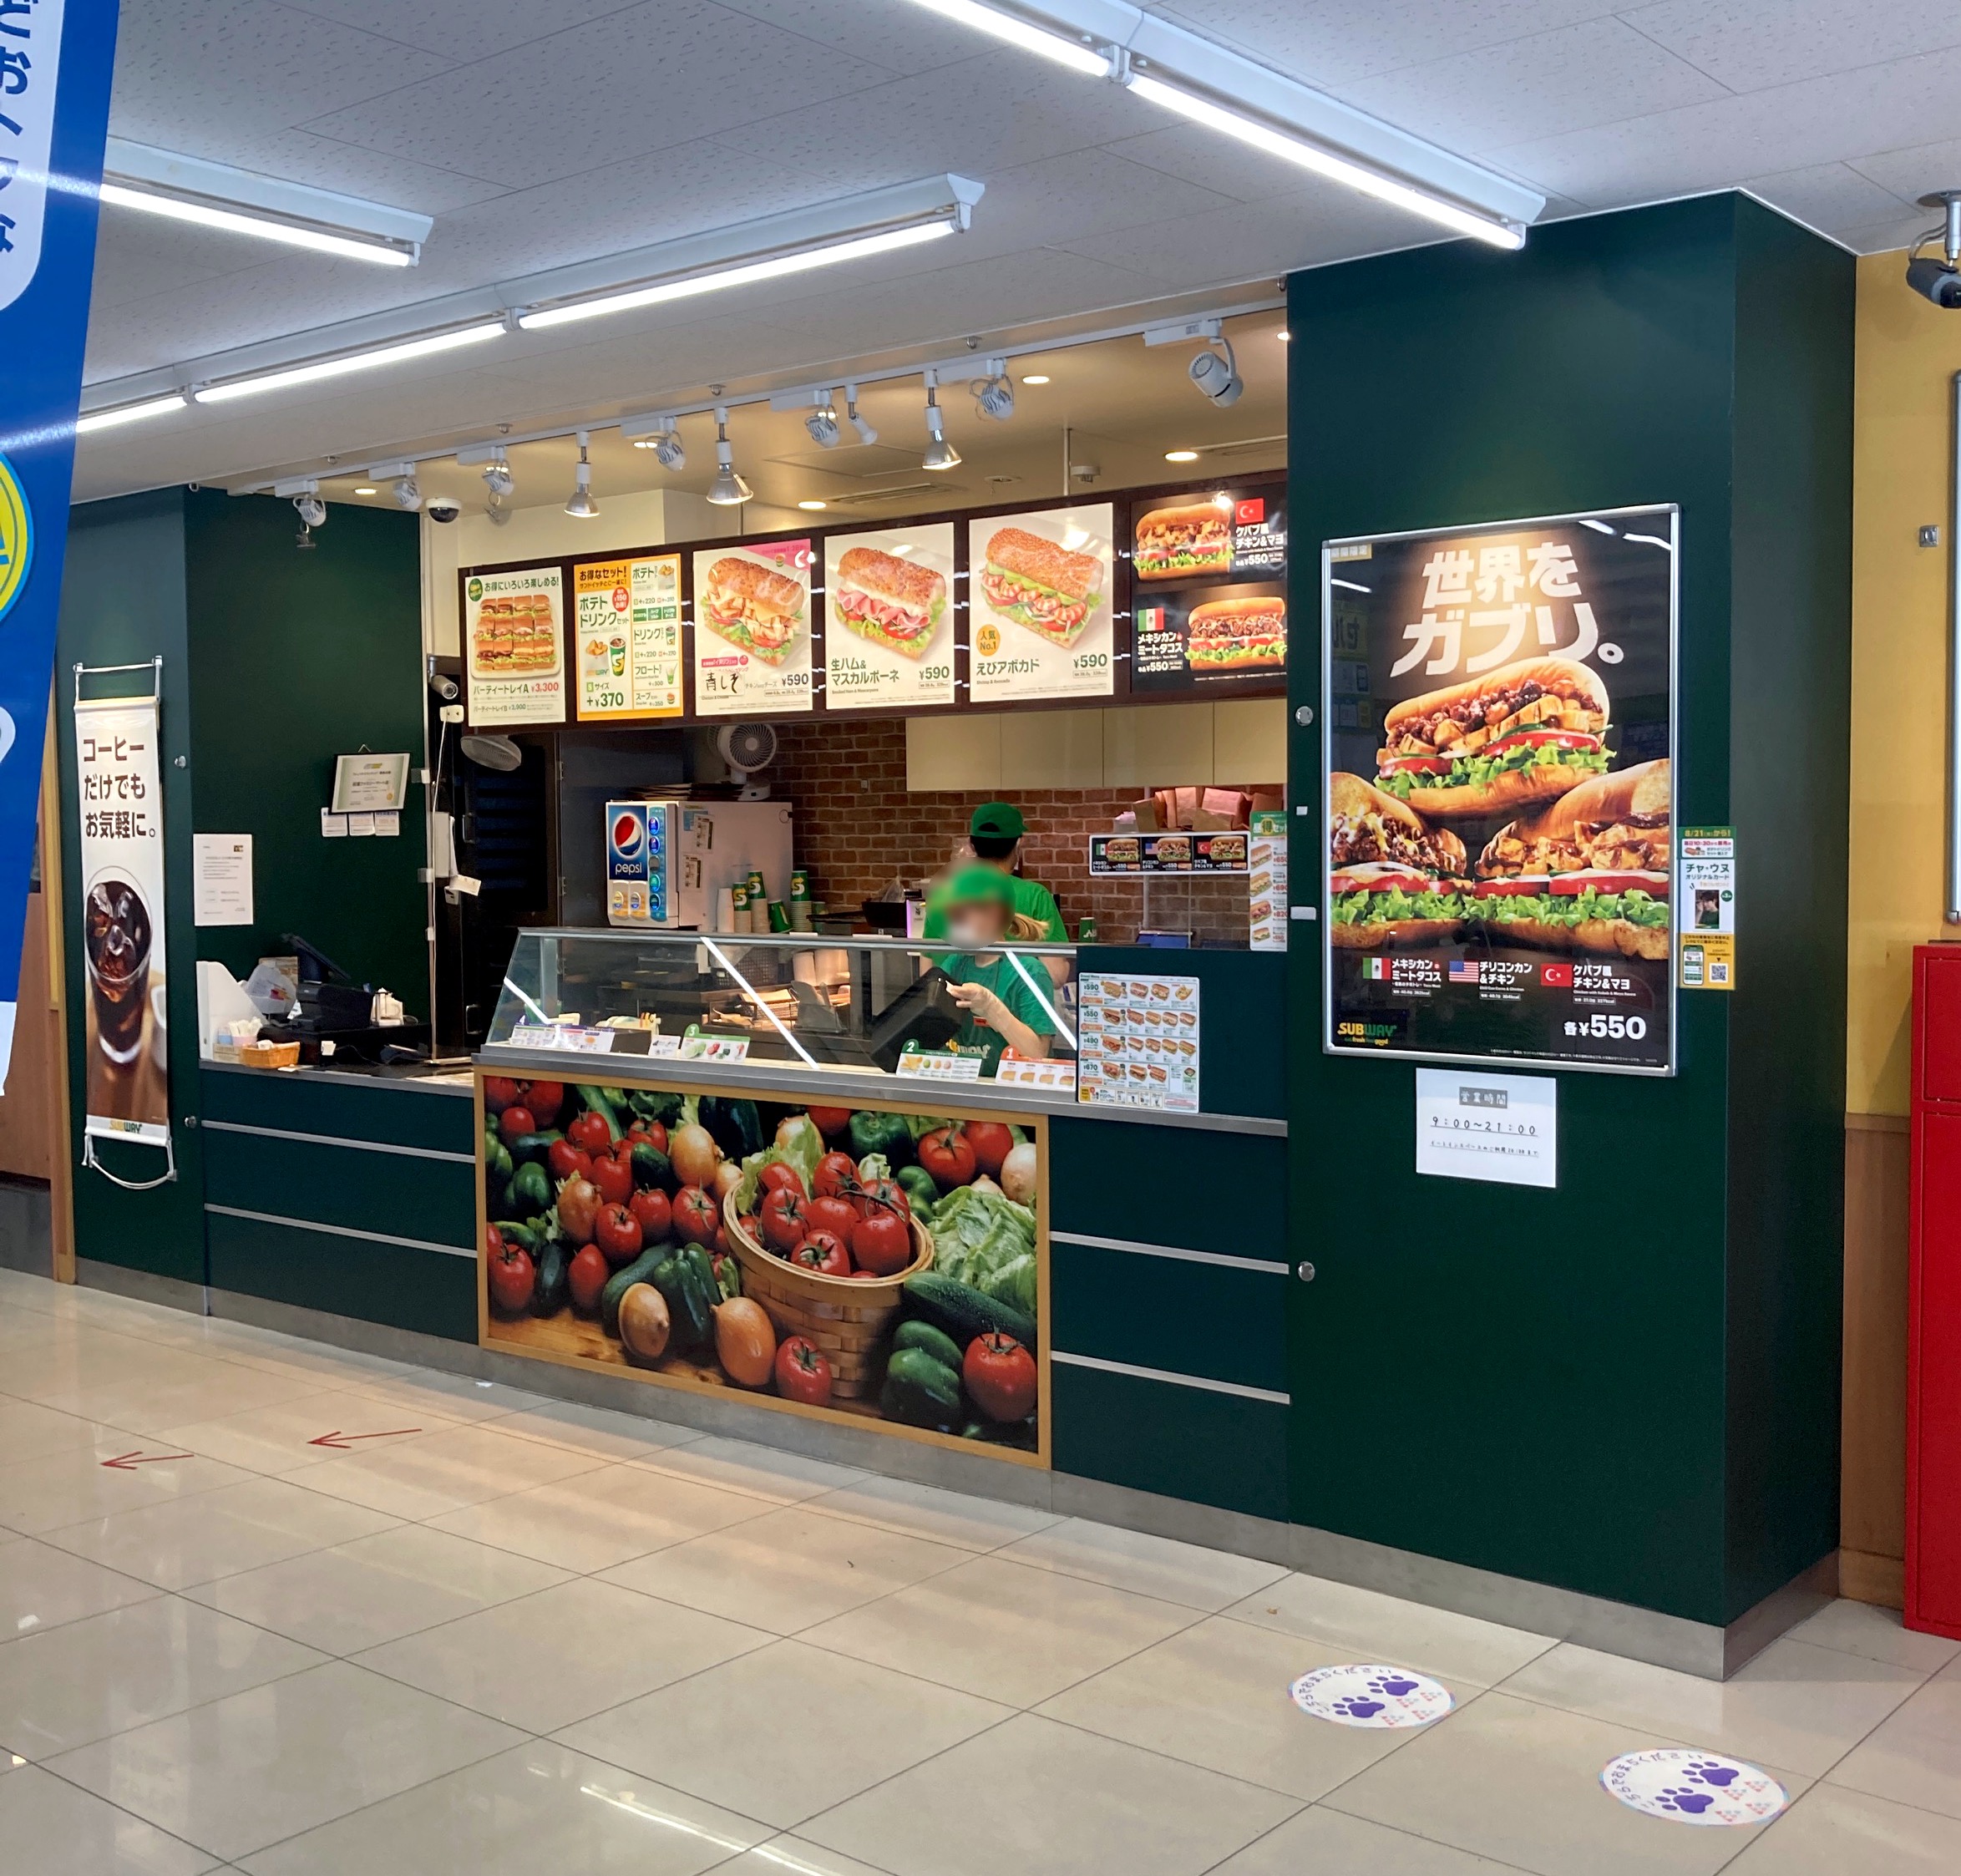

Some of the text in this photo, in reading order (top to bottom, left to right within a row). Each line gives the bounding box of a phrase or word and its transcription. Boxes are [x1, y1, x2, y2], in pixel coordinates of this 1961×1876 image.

[580, 565, 626, 581] お得なセット!
[1422, 542, 1582, 609] 世界を
[484, 576, 559, 592] お得にいろいろ楽しめる!
[580, 596, 608, 611] ポテト
[980, 631, 996, 640] 人気
[1138, 632, 1176, 644] メキシカン
[1390, 602, 1624, 677] ガブリ。
[980, 641, 996, 650] No.1
[1138, 642, 1183, 656] ミートタコス
[831, 657, 866, 671] 生ハム&
[976, 659, 1040, 676] えびアボカド
[1073, 654, 1107, 668] ¥590
[782, 673, 808, 686] ¥590
[831, 669, 899, 686] マスカルポーネ
[920, 667, 950, 680] ¥590
[531, 682, 559, 692] ¥3,300
[706, 672, 738, 693] 青しそ
[84, 736, 144, 762] コーヒー
[84, 773, 145, 800] だけでも
[85, 810, 156, 839] お気軽に。
[616, 862, 642, 875] pepsi
[1686, 864, 1730, 873] チャ・ウヌ
[1391, 958, 1433, 969] メキシカン
[1479, 961, 1533, 973] チリコンカン
[1391, 970, 1442, 981] ミートタコス
[1573, 965, 1612, 976] ケバブ風
[1479, 973, 1515, 985] &チキン
[1573, 977, 1630, 990] チキン&マヨ
[519, 1015, 525, 1025] 4
[688, 1027, 696, 1037] 3
[1337, 1022, 1397, 1037] SUBWAY
[906, 1042, 915, 1052] 2
[1006, 1047, 1014, 1059] 1
[1460, 1090, 1507, 1105] 営業時間
[1299, 1666, 1391, 1714] こちらでおまちください
[1611, 1752, 1702, 1809] こちらでおまちください
